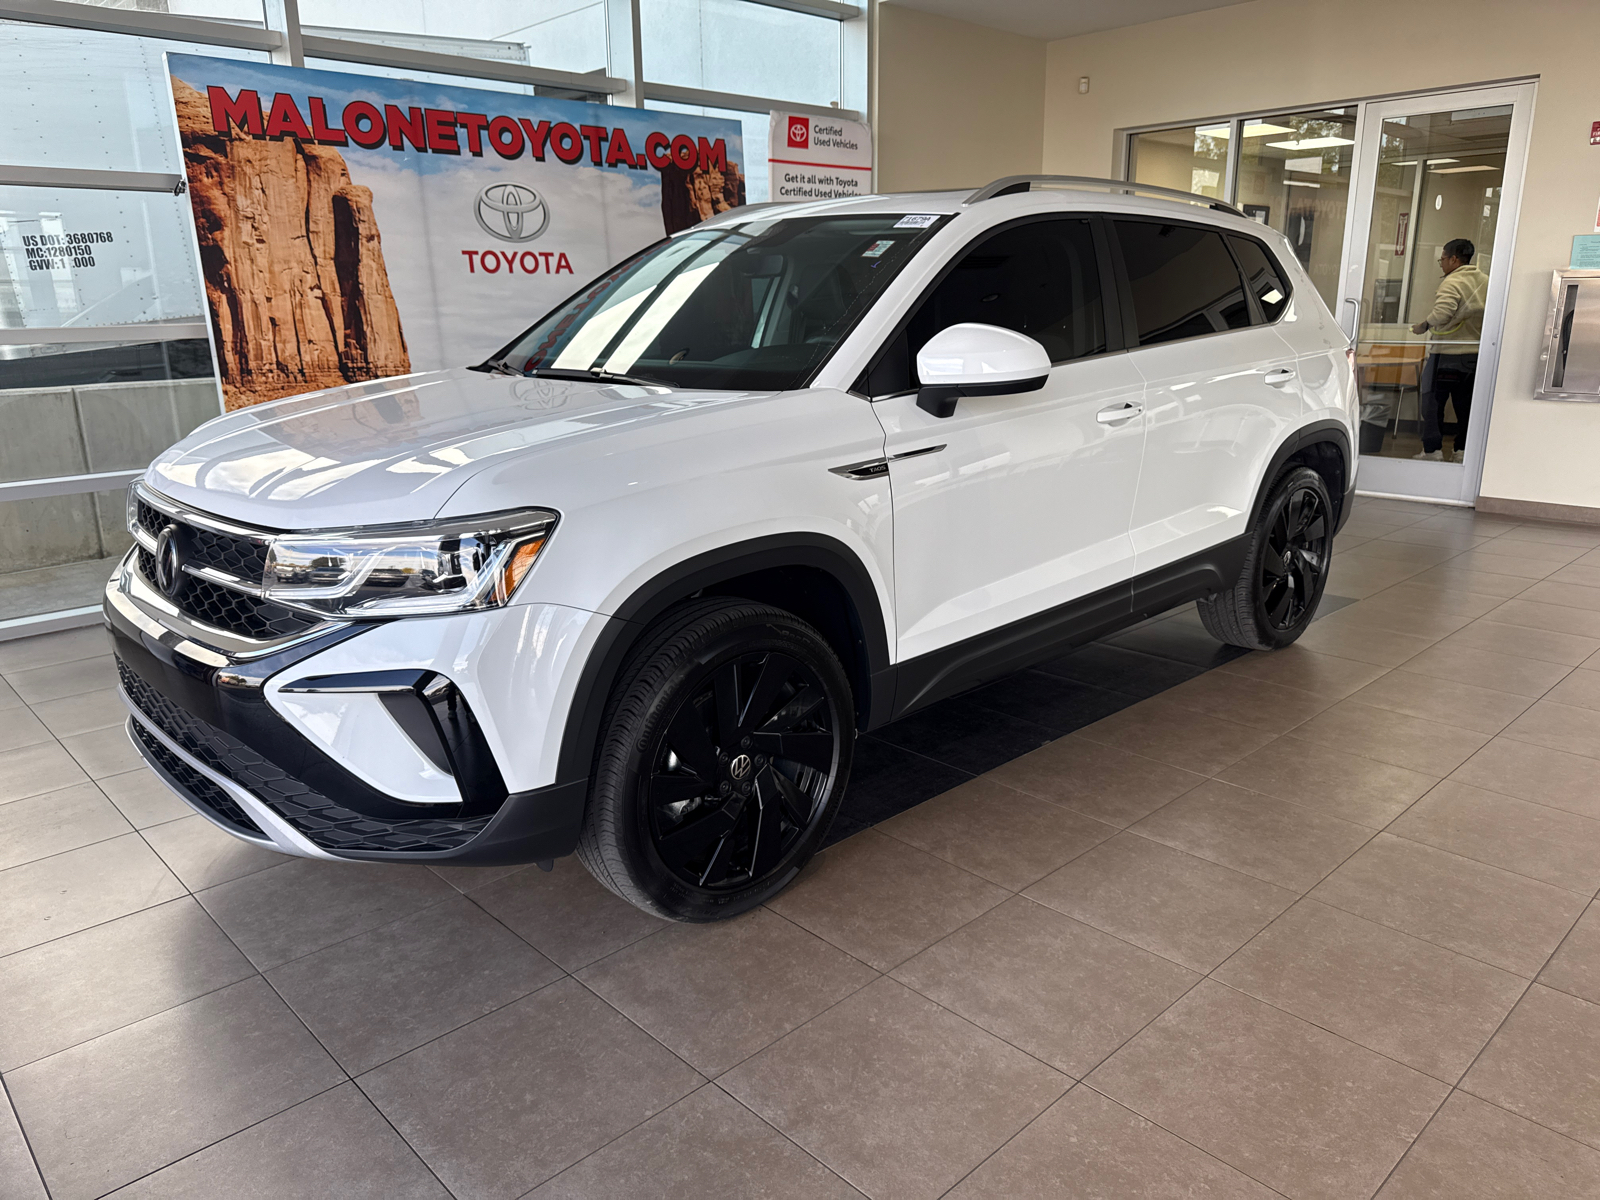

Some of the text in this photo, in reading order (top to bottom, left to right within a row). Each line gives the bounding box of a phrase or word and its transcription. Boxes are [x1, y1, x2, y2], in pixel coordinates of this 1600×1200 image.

[206, 86, 728, 174] MALONETOYOTA.COM
[814, 125, 842, 136] Certified
[814, 137, 858, 150] Used Vehicles
[784, 173, 858, 189] Get it all with Toyota
[780, 186, 813, 197] Certified
[814, 188, 832, 198] Used
[22, 231, 114, 247] US DOT: 3680768
[25, 244, 92, 259] MC:1280150
[461, 250, 574, 275] TOYOTA
[870, 465, 886, 473] TAOS
